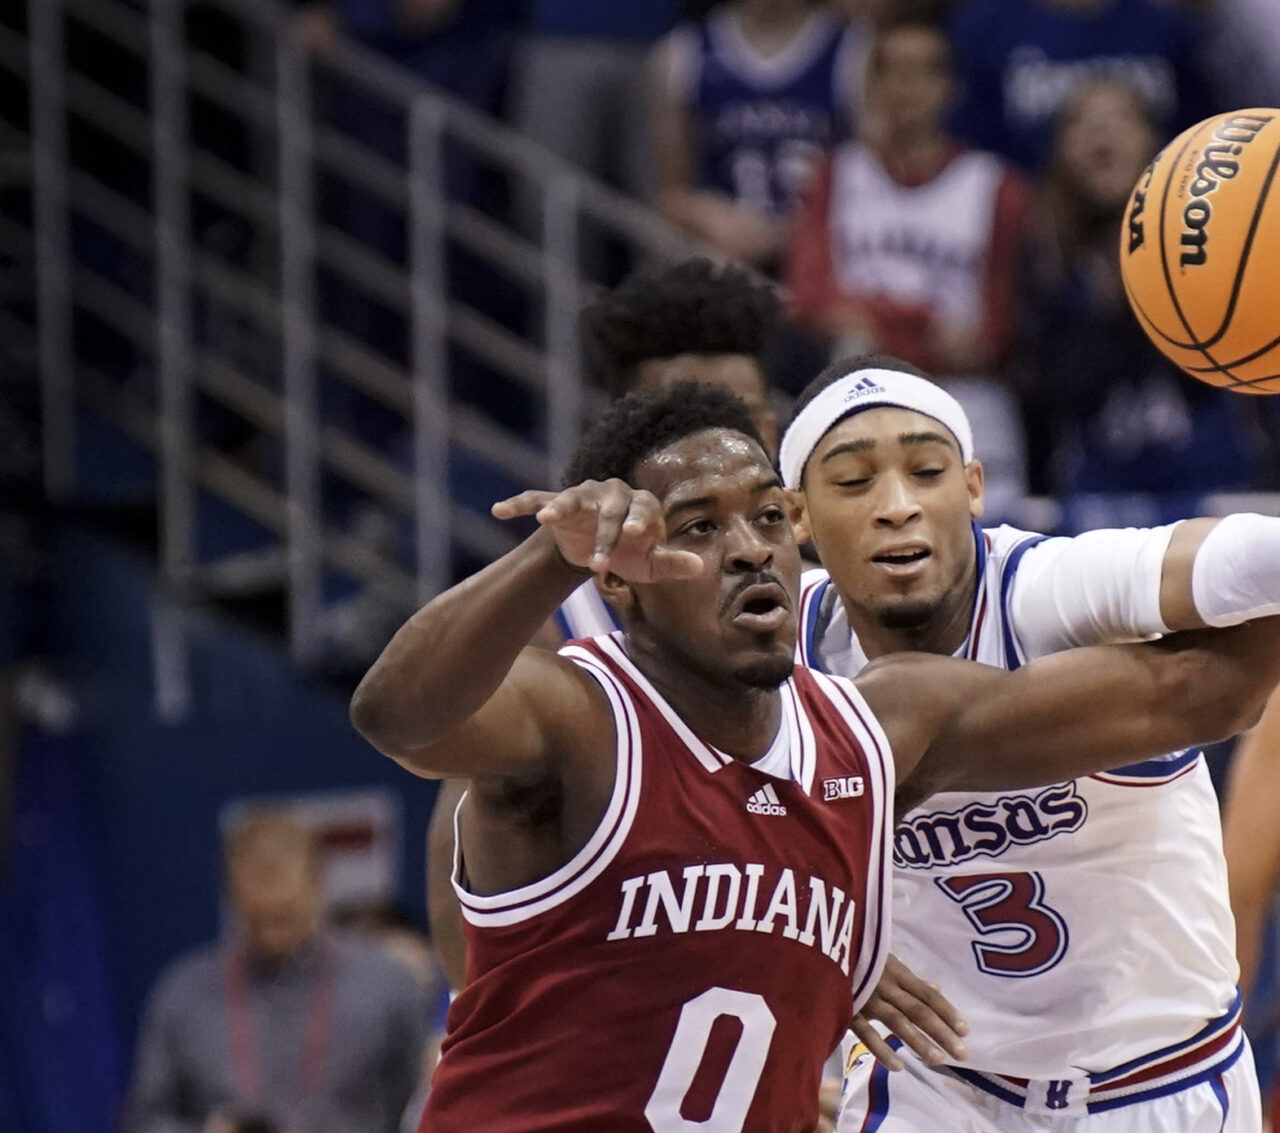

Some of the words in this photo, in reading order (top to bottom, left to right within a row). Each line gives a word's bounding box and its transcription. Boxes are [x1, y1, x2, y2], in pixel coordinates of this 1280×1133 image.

[1179, 115, 1276, 268] Wilson
[844, 386, 887, 403] adidas
[746, 802, 787, 817] adidas
[893, 780, 1088, 870] ansas
[606, 863, 856, 977] INDIANA
[934, 870, 1069, 979] 3
